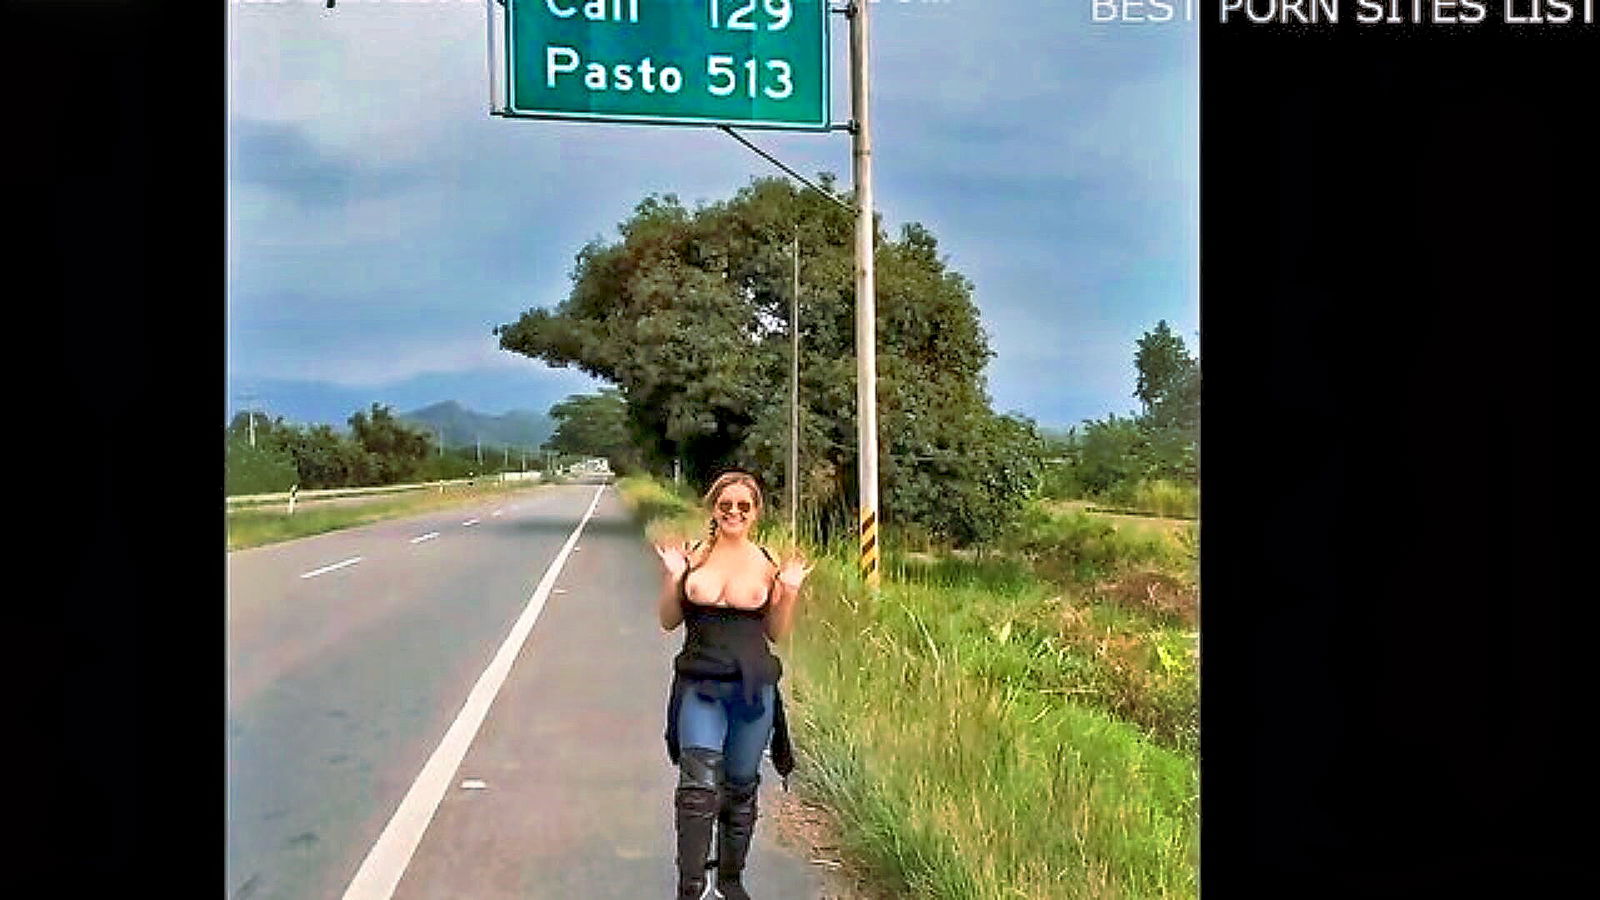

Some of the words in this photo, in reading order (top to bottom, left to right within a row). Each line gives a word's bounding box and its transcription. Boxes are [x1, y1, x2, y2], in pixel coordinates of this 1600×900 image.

[710, 0, 793, 31] 129
[546, 47, 683, 93] Pasto
[706, 55, 794, 99] 513
